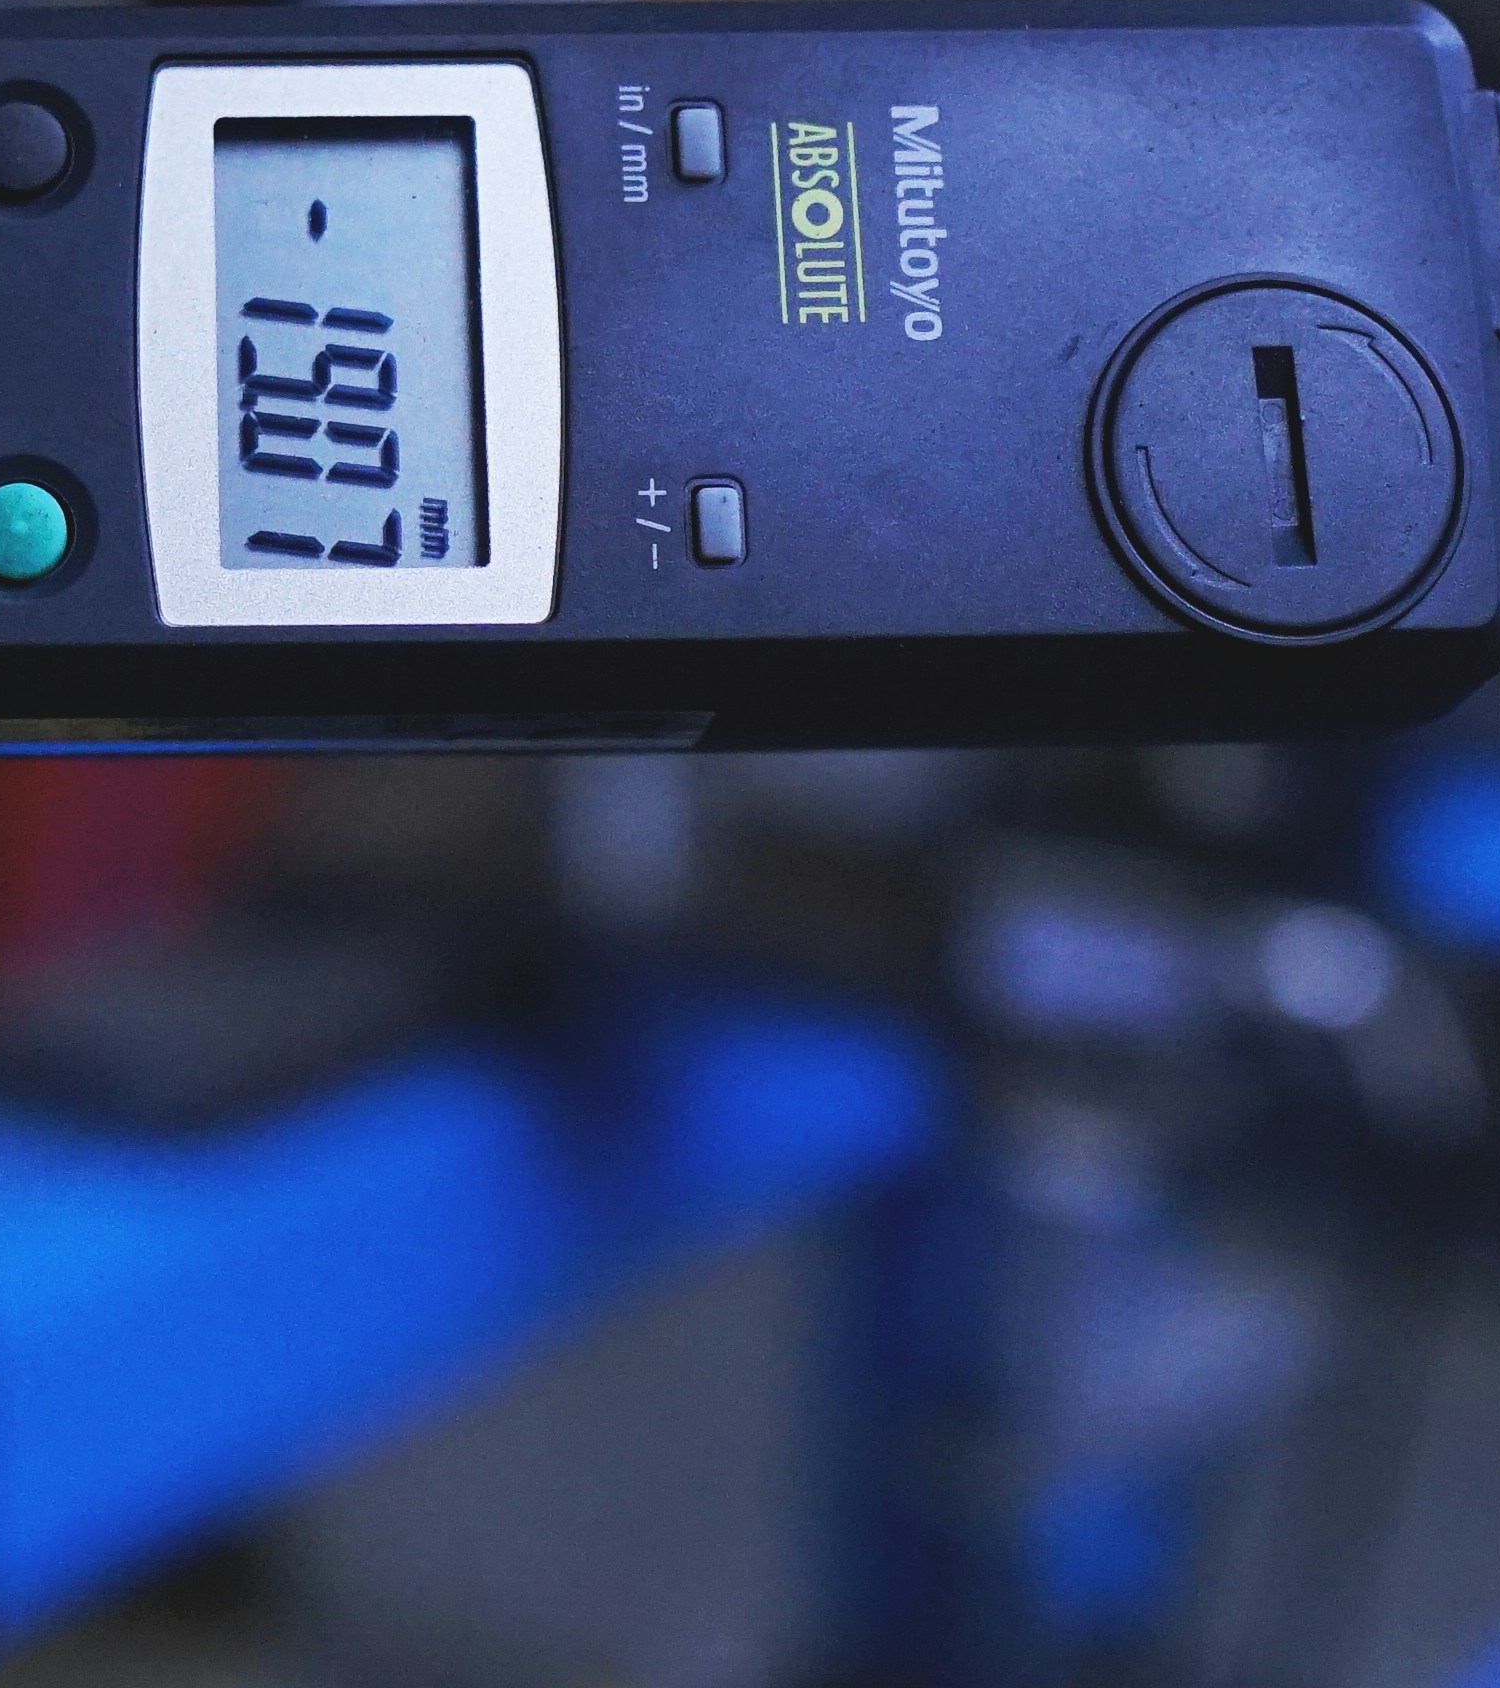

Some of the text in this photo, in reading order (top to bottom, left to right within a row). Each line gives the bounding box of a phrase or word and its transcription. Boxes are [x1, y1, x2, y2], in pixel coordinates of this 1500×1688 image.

[788, 122, 849, 324] ABSOLUTE
[889, 105, 948, 341] Mitutoyo
[419, 497, 450, 559] mm
